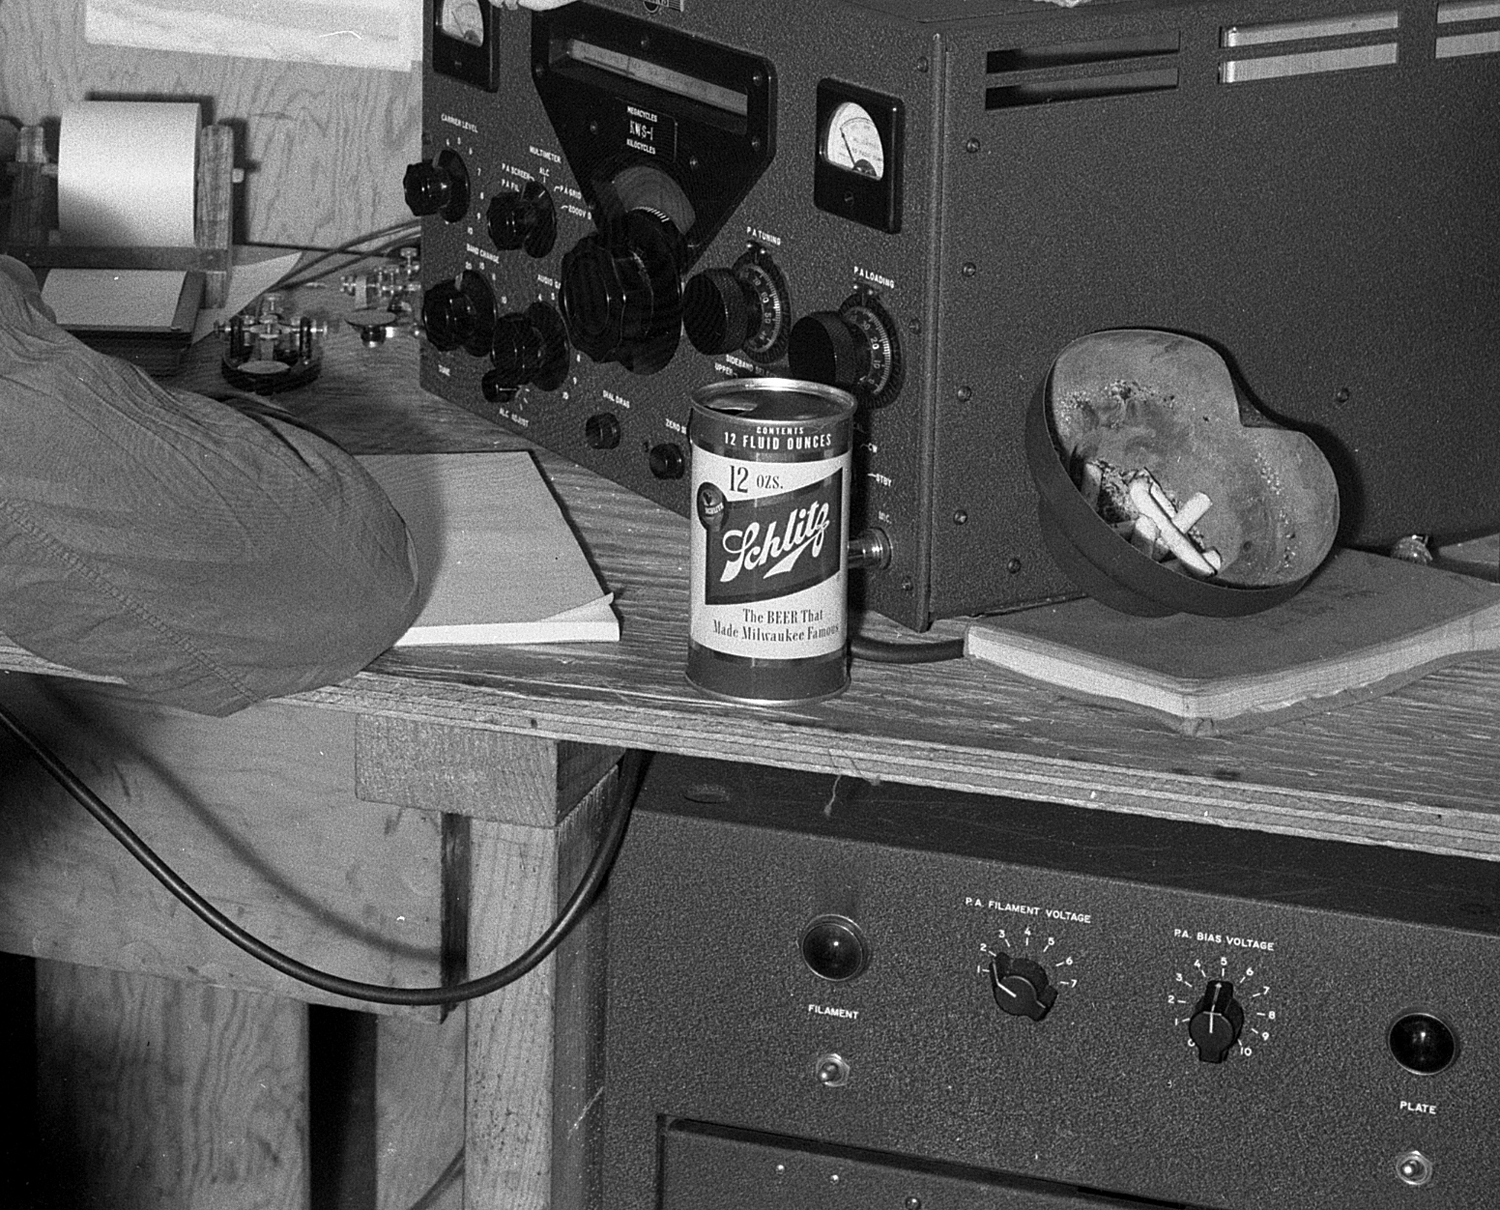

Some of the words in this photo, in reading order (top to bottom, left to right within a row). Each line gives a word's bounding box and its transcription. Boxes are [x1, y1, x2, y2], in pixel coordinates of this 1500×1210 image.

[627, 105, 658, 123] MEGACYCLES
[629, 120, 654, 141] KWS-1
[529, 145, 562, 164] MULTIMETER
[758, 231, 782, 246] TUNING
[865, 269, 895, 289] LOADING
[870, 336, 880, 350] 20
[714, 362, 733, 376] UPPER
[725, 354, 754, 372] SIDEBAND
[665, 418, 680, 432] ZERO
[756, 426, 804, 435] CONTENTS
[724, 432, 736, 446] 12
[743, 435, 780, 450] FLUID
[787, 433, 832, 450] OUNCES
[728, 465, 749, 494] 12
[876, 473, 892, 487] STBY
[720, 501, 830, 582] Schlitz
[743, 609, 764, 624] The
[767, 609, 798, 624] BEER
[800, 608, 823, 622] That
[713, 619, 739, 638] Made
[742, 626, 805, 642] Milwaukee
[807, 624, 840, 641] Famous
[988, 900, 1040, 916] FILAMENT
[1045, 910, 1091, 924] VOLTAGE
[999, 929, 1005, 938] 3
[1024, 927, 1031, 936] 4
[980, 943, 987, 952] 2
[1048, 937, 1055, 946] 5
[1196, 932, 1222, 944] BIAS
[1226, 935, 1275, 951] VOLTAGE
[1065, 956, 1073, 966] 6
[1194, 959, 1201, 969] 4
[1220, 957, 1228, 966] 5
[1176, 973, 1183, 981] 3
[1246, 967, 1254, 976] 6
[1071, 979, 1077, 988] 7
[1263, 986, 1270, 995] 7
[1168, 995, 1175, 1004] 2
[807, 1003, 860, 1020] FILAMENT
[1268, 1011, 1275, 1020] 8
[1262, 1032, 1269, 1041] 9
[1240, 1047, 1252, 1057] 10
[1399, 1100, 1437, 1115] PLATE
